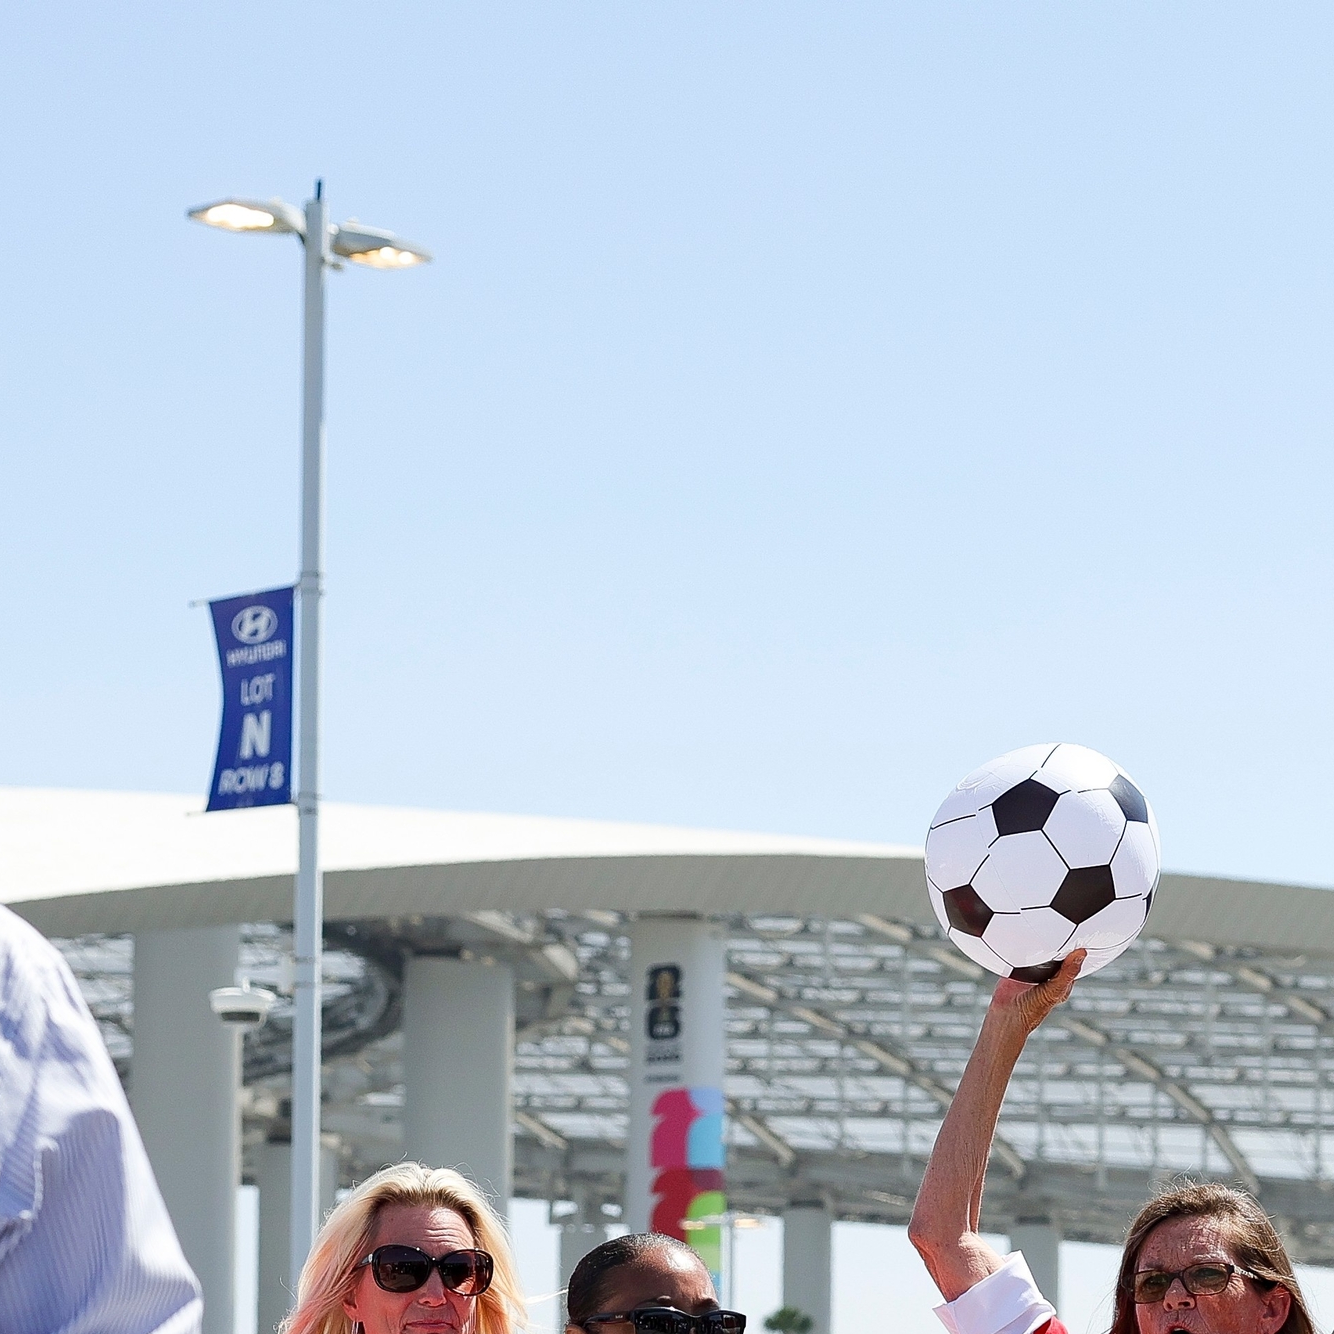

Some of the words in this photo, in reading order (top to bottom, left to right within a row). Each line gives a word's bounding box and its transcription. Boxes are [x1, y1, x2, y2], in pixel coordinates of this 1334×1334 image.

[240, 672, 276, 706] LOT
[241, 710, 272, 760] N
[218, 763, 269, 795] ROW
